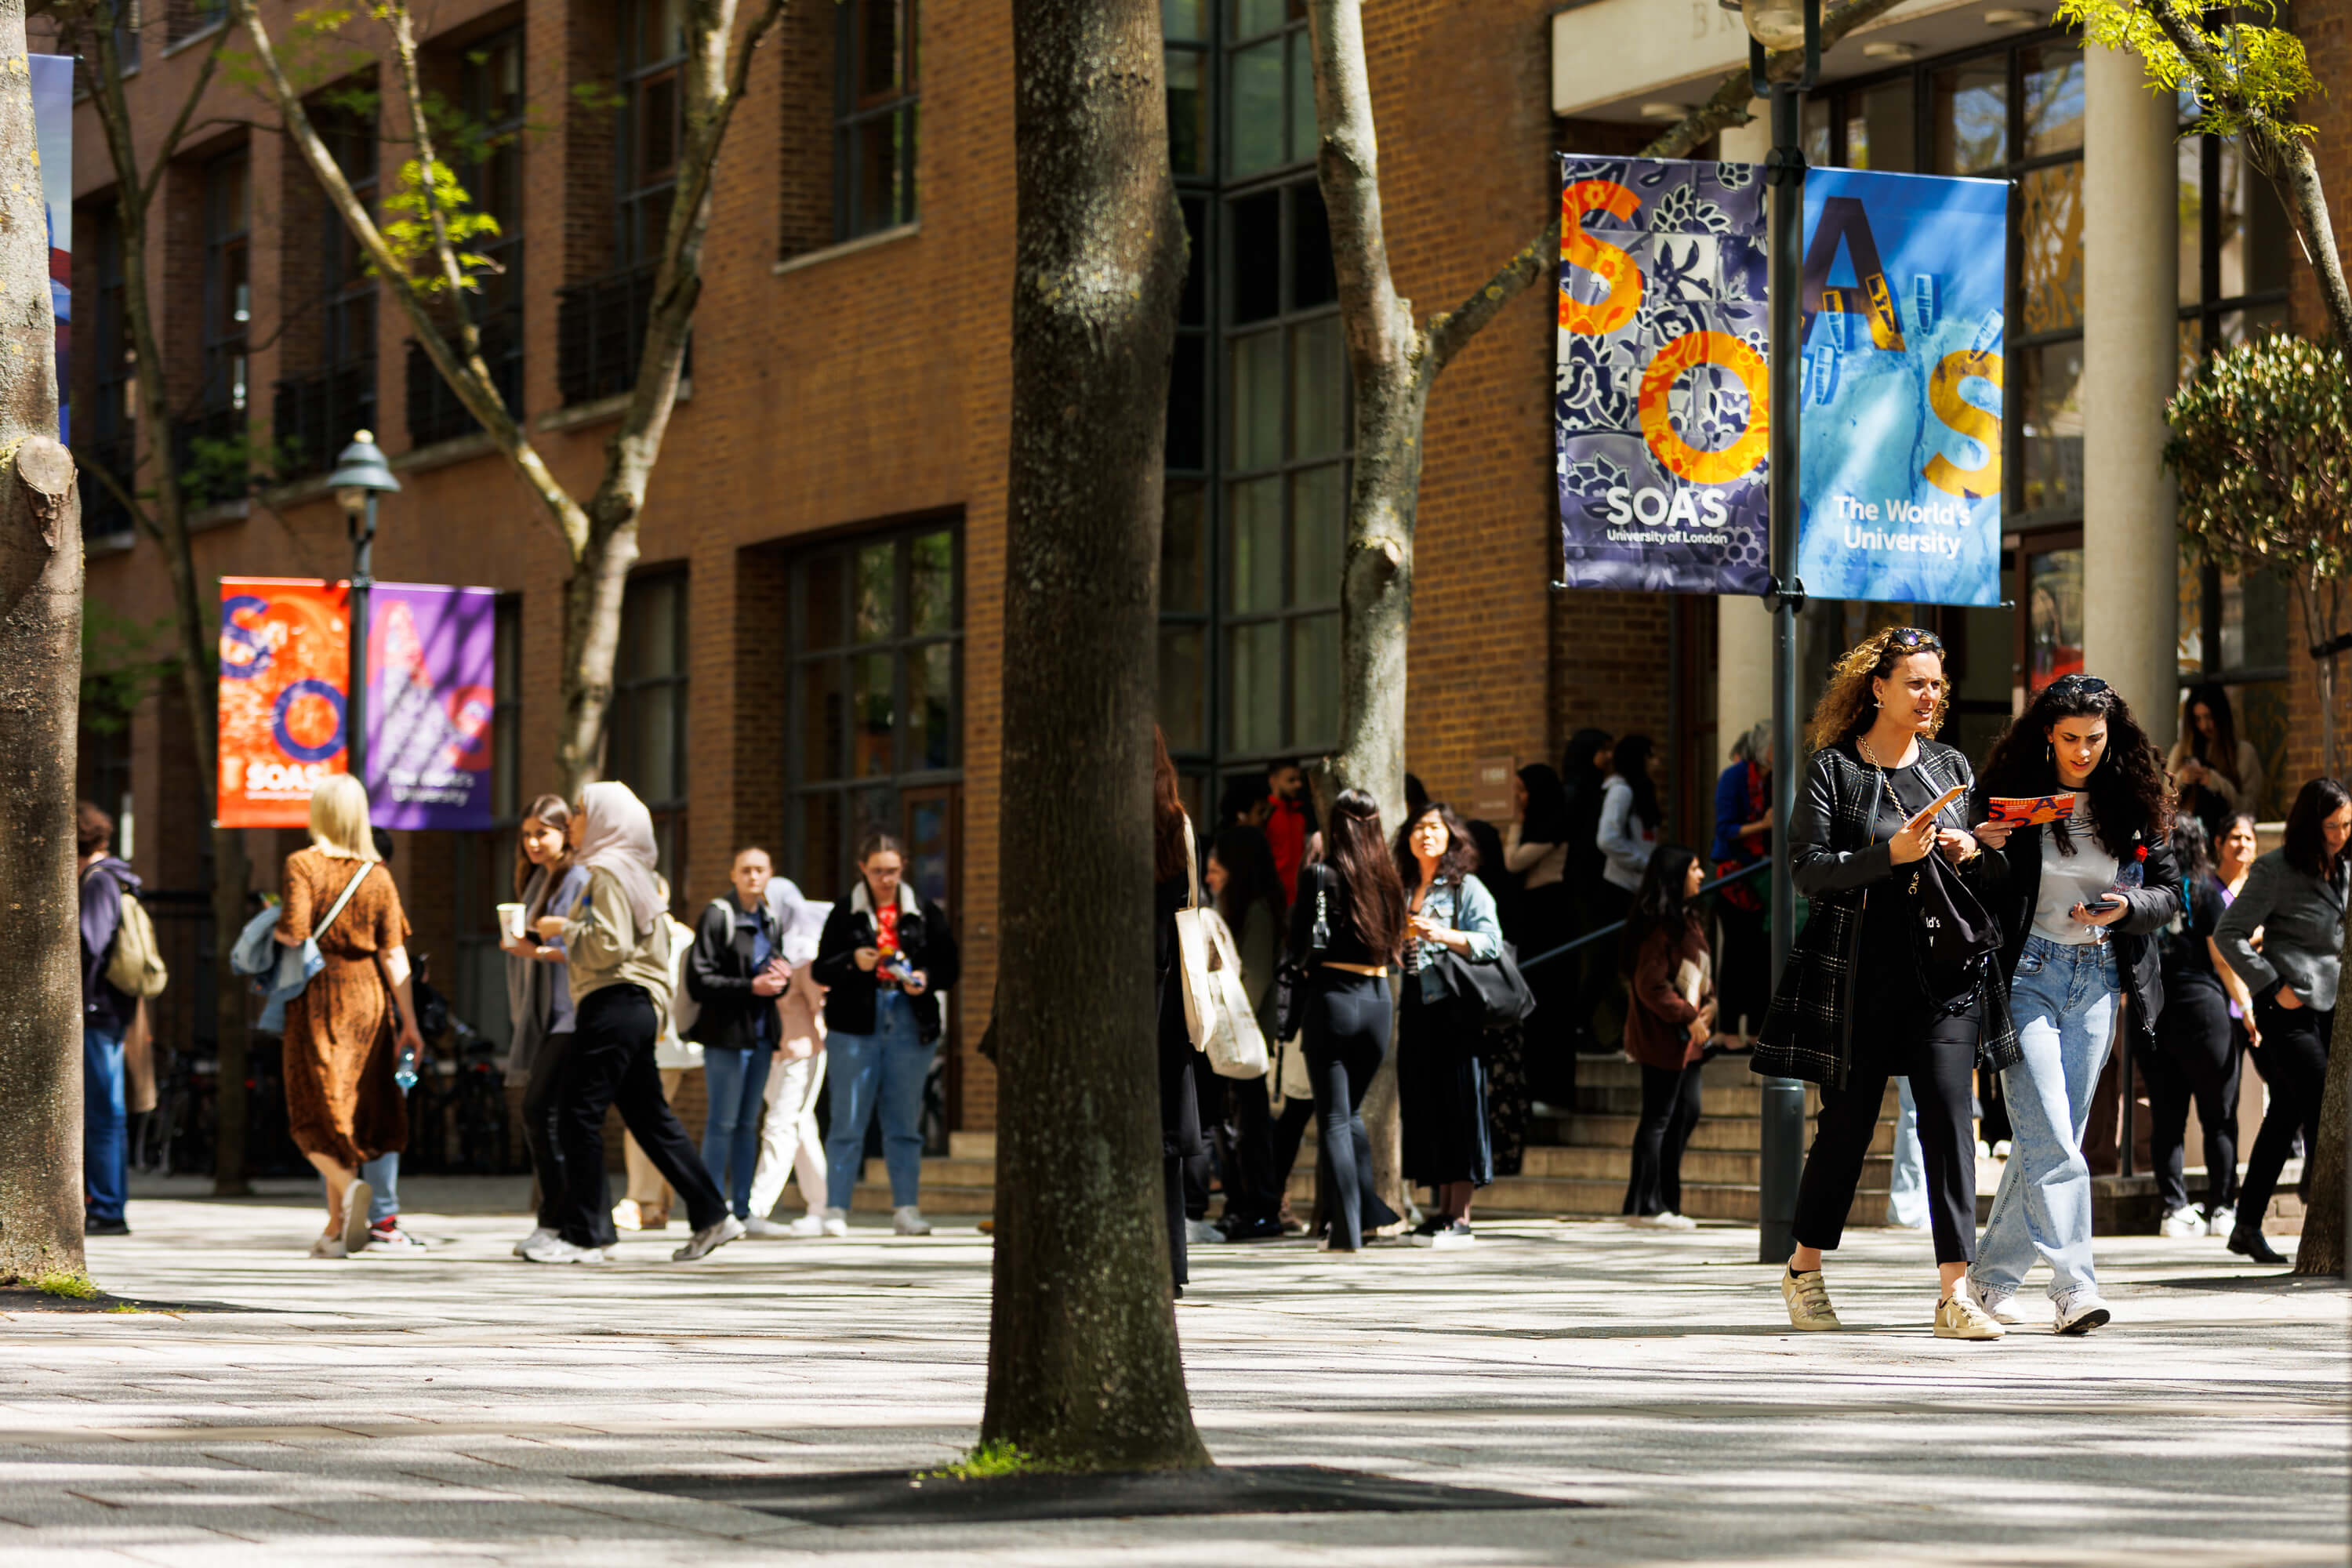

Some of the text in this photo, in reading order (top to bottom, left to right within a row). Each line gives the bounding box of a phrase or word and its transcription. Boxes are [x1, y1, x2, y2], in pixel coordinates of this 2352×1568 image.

[1606, 486, 1728, 528] SOAS
[1832, 495, 1971, 526] The World's
[1607, 528, 1728, 545] University of London
[1844, 524, 1961, 560] University
